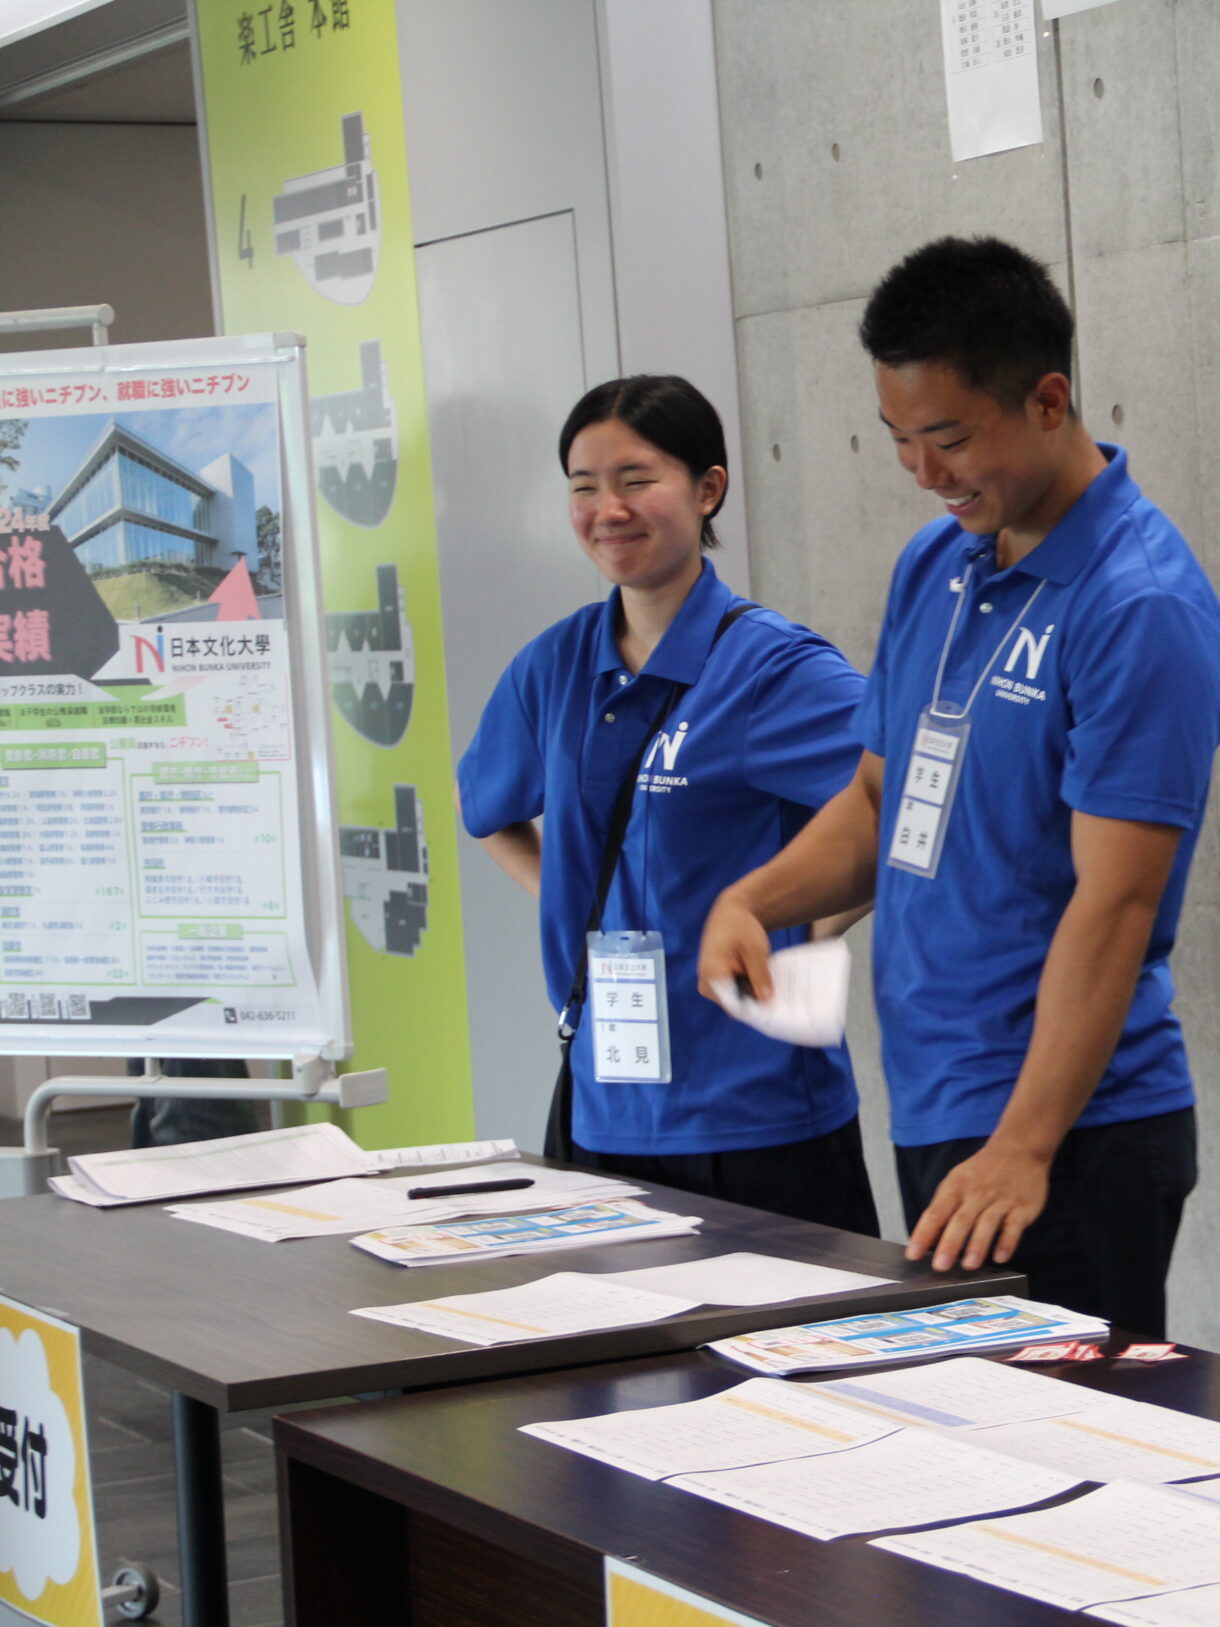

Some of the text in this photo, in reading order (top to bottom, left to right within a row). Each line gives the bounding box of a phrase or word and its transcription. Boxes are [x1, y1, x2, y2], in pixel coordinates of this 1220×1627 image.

[0, 373, 251, 408] に強いニチブン、就職に強いニチブン
[0, 535, 46, 590] 格
[171, 633, 271, 658] 日本文化大學
